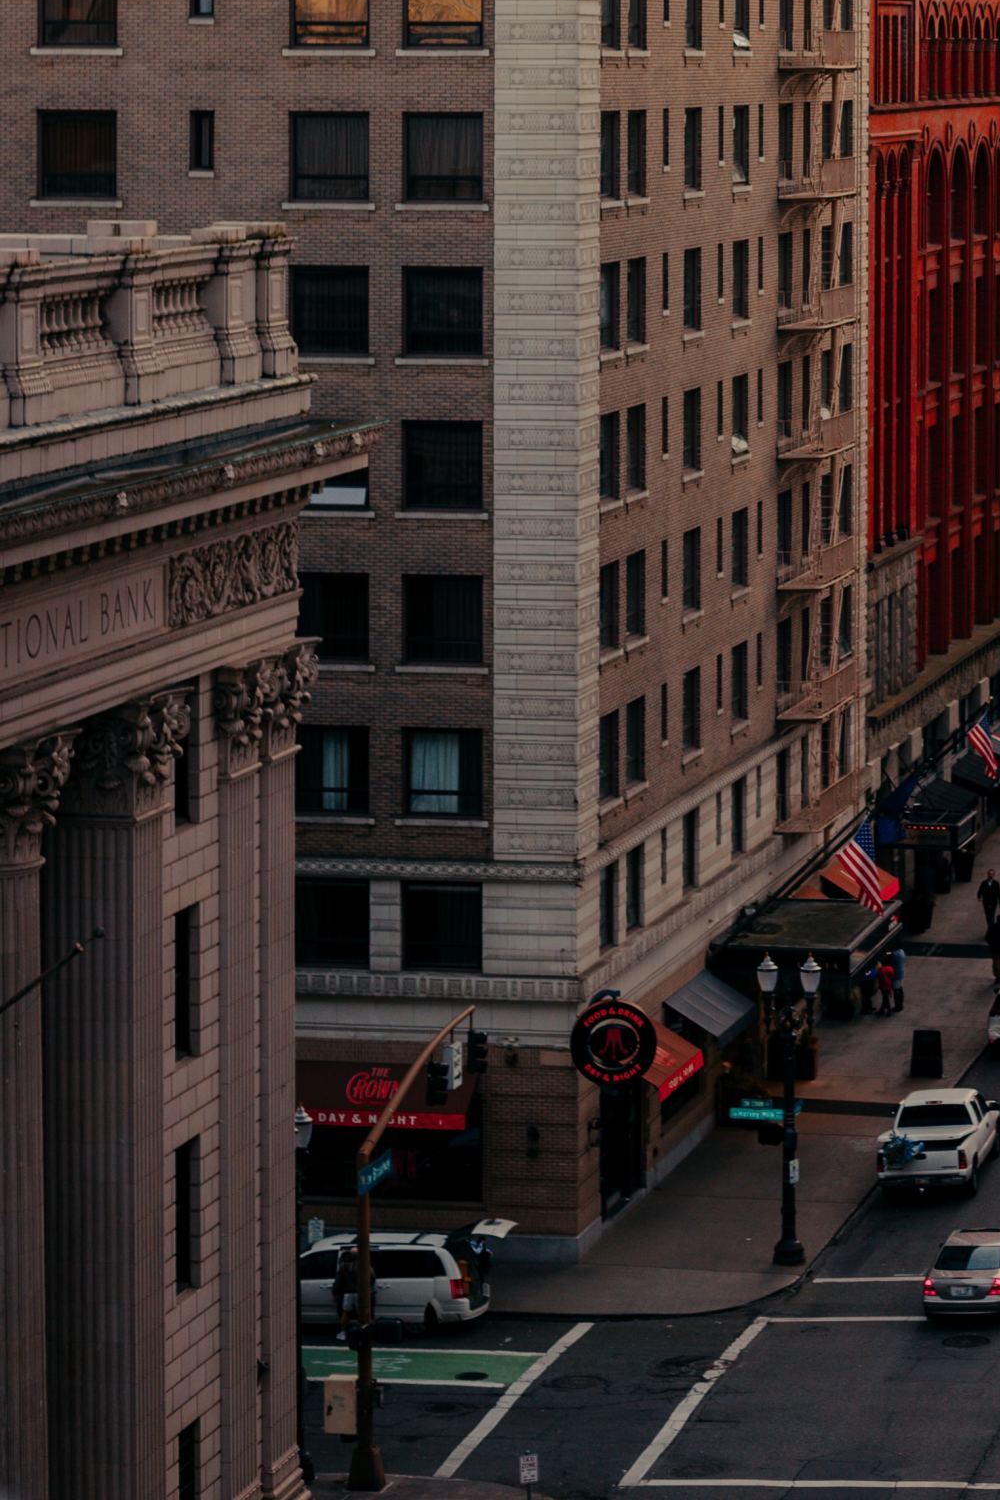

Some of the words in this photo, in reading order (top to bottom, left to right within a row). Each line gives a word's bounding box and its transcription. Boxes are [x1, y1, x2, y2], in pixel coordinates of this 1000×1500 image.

[0, 600, 89, 668] TIONAL
[100, 578, 154, 636] BANK
[583, 1007, 608, 1028] FOOD
[608, 1006, 616, 1015] &
[618, 1007, 646, 1027] DRINK
[371, 1067, 392, 1078] THE
[583, 1062, 603, 1080] DAY
[602, 1074, 611, 1085] &
[613, 1063, 642, 1083] NIGHT
[318, 1113, 346, 1123] DAY
[351, 1114, 362, 1124] &
[368, 1114, 417, 1126] NGHT
